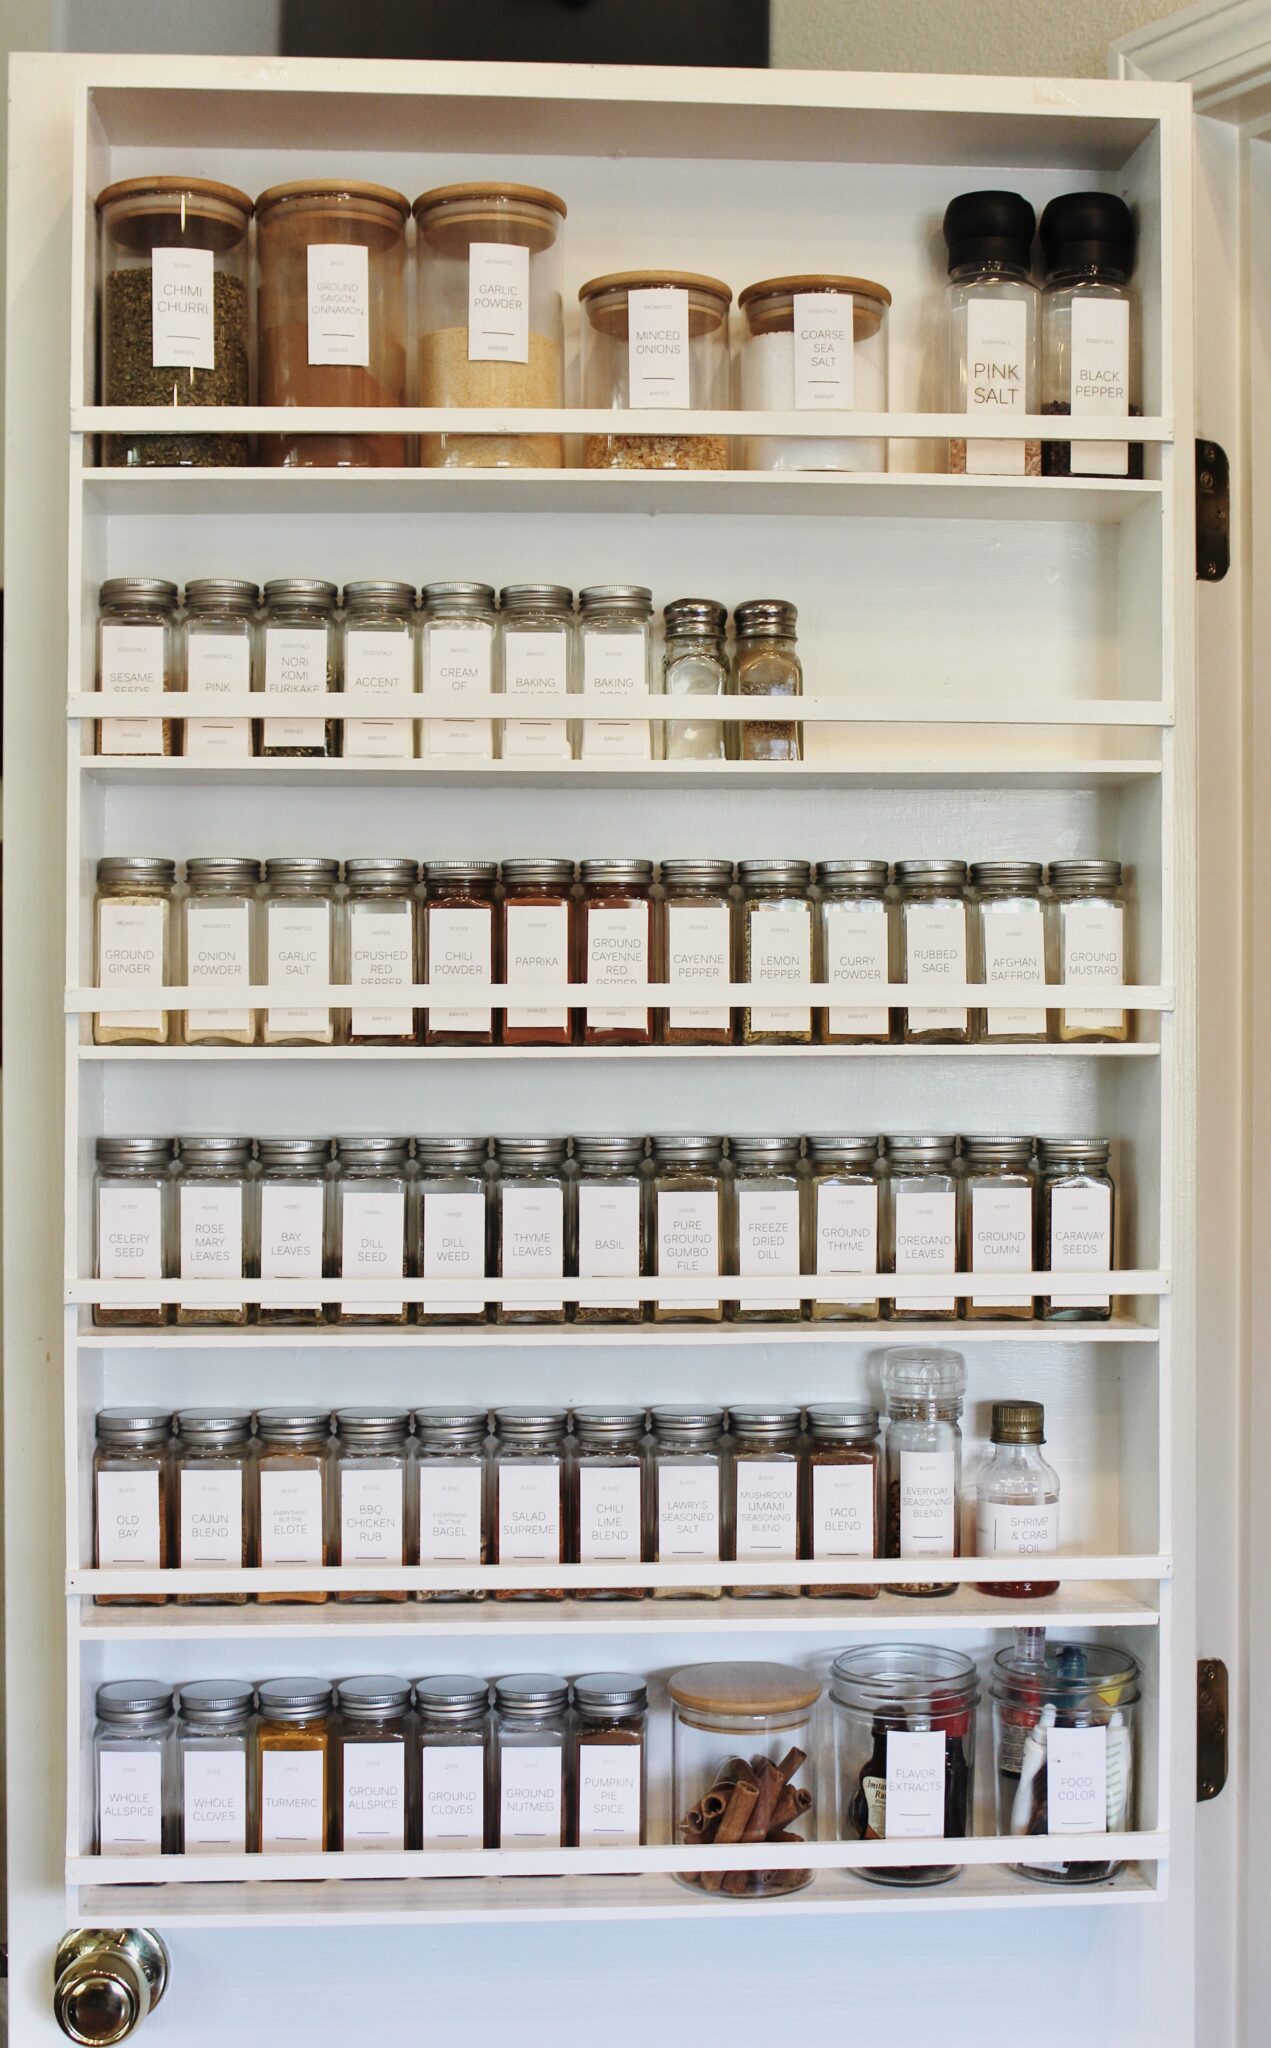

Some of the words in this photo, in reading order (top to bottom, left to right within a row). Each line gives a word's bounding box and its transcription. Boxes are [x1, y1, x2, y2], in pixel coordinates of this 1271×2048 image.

[162, 283, 204, 298] CHIMI
[316, 282, 359, 293] GROUND
[478, 283, 518, 297] GARLIC
[319, 294, 356, 305] SAIGON
[473, 297, 523, 310] POWDER
[156, 300, 209, 316] CHURRI
[311, 305, 365, 317] CINNAMON
[635, 330, 681, 342] MINCED
[800, 329, 845, 341] COARSE
[635, 343, 681, 356] ONIONS
[812, 343, 835, 354] SEA
[811, 356, 837, 368] SALT
[973, 362, 1020, 380] PINK
[1079, 369, 1120, 383] BLACK
[973, 387, 1020, 405] SALT
[1075, 384, 1123, 399] PEPPER
[281, 656, 309, 667] NORI
[109, 672, 154, 684] SESAME
[280, 670, 309, 681] KOMI
[440, 667, 479, 678] CREAM
[205, 682, 231, 693] PINK
[355, 676, 400, 688] ACCENT
[451, 680, 467, 692] OF
[515, 677, 556, 688] BAKING
[594, 677, 634, 689] BAKING
[268, 683, 320, 693] FURIKAKE
[592, 937, 642, 949] GROUND
[104, 949, 155, 961] GROUND
[198, 951, 236, 962] ONION
[278, 951, 317, 962] GARLIC
[353, 950, 409, 962] CRUSHED
[444, 950, 473, 962] CHILI
[591, 951, 643, 962] CAYENNE
[673, 953, 724, 965] CAYENNE
[760, 955, 800, 966] LEMON
[913, 949, 958, 961] RUBBED
[1070, 951, 1117, 963] GROUND
[515, 956, 559, 967] PAPRIKA
[839, 955, 876, 967] CURRY
[993, 956, 1037, 969] AFGHAN
[108, 963, 151, 974] GINGER
[193, 964, 242, 976] POWDER
[285, 964, 311, 976] SALT
[370, 963, 393, 975] RED
[434, 964, 483, 976] POWDER
[605, 965, 628, 976] RED
[678, 967, 720, 978] PEPPER
[921, 962, 951, 974] SAGE
[1068, 965, 1119, 977] MUSTARD
[760, 968, 801, 980] PEPPER
[833, 969, 881, 981] POWDER
[990, 970, 1040, 982] SAFFRON
[195, 1223, 225, 1234] ROSE
[673, 1220, 703, 1231] PURE
[748, 1222, 789, 1233] FREEZE
[108, 1233, 150, 1244] CELERY
[281, 1232, 302, 1243] BAY
[513, 1232, 551, 1243] THYME
[663, 1233, 712, 1244] GROUND
[822, 1227, 871, 1239] GROUND
[977, 1231, 1026, 1242] GROUND
[1055, 1231, 1105, 1242] CARAWAY
[194, 1237, 225, 1248] MARY
[360, 1238, 384, 1249] DILL
[441, 1237, 464, 1249] DILL
[594, 1239, 625, 1250] BASIL
[751, 1235, 785, 1247] DRIED
[898, 1235, 953, 1246] OREGANO
[271, 1245, 311, 1256] LEAVES
[512, 1246, 553, 1257] LEAVES
[828, 1241, 865, 1252] THYME
[983, 1244, 1020, 1255] CUMIN
[1062, 1243, 1098, 1255] SEEDS
[114, 1247, 145, 1258] SEED
[190, 1250, 231, 1262] LEAVES
[357, 1251, 387, 1263] SEED
[436, 1250, 470, 1262] WEED
[666, 1247, 709, 1258] GUMBO
[757, 1249, 780, 1260] DILL
[905, 1248, 945, 1259] LEAVES
[676, 1260, 699, 1271] FILE
[740, 1490, 793, 1500] MUSHROOM
[906, 1486, 950, 1497] EVERYDAY
[747, 1501, 786, 1512] UMAMI
[902, 1496, 953, 1507] SEASONING
[359, 1504, 383, 1516] BBQ
[595, 1503, 624, 1514] CHILI
[828, 1507, 857, 1518] TACO
[912, 1508, 943, 1519] BLEND
[115, 1514, 140, 1526] OLD
[191, 1513, 229, 1525] CAJUN
[511, 1511, 547, 1522] SALAD
[597, 1516, 623, 1528] LIME
[661, 1512, 715, 1522] SEASONED
[741, 1513, 791, 1522] SEASONING
[1009, 1516, 1049, 1528] SHRIMP
[346, 1518, 396, 1529] CHICKEN
[676, 1524, 699, 1534] SALT
[751, 1523, 781, 1533] BLEND
[824, 1520, 861, 1532] BLEND
[118, 1528, 139, 1539] BAY
[191, 1527, 229, 1538] BLEND
[273, 1524, 308, 1536] ELOTE
[432, 1526, 468, 1537] BAGEL
[503, 1524, 555, 1536] SUPREME
[591, 1530, 629, 1541] BLEND
[1010, 1530, 1019, 1541] &
[1021, 1529, 1048, 1541] CRAB
[359, 1531, 383, 1542] RUB
[1018, 1544, 1042, 1555] BOIL
[895, 1768, 936, 1779] FLAVOR
[584, 1776, 634, 1789] PUMPKIN
[867, 1779, 887, 1789] Imita
[888, 1780, 942, 1793] EXTRACTS
[1060, 1776, 1093, 1788] FOOD
[348, 1786, 398, 1797] GROUND
[427, 1790, 477, 1802] GROUND
[506, 1788, 555, 1799] GROUND
[600, 1790, 617, 1801] PIE
[1057, 1789, 1096, 1801] COLOR
[108, 1792, 150, 1804] WHOLE
[193, 1797, 235, 1809] WHOLE
[265, 1797, 319, 1809] TURMERIC
[347, 1799, 399, 1810] ALLSPICE
[430, 1804, 474, 1815] CLOVES
[506, 1801, 555, 1813] NUTMEG
[593, 1803, 625, 1815] SPICE
[104, 1806, 155, 1817] ALLSPICE
[192, 1811, 236, 1822] CLOVES
